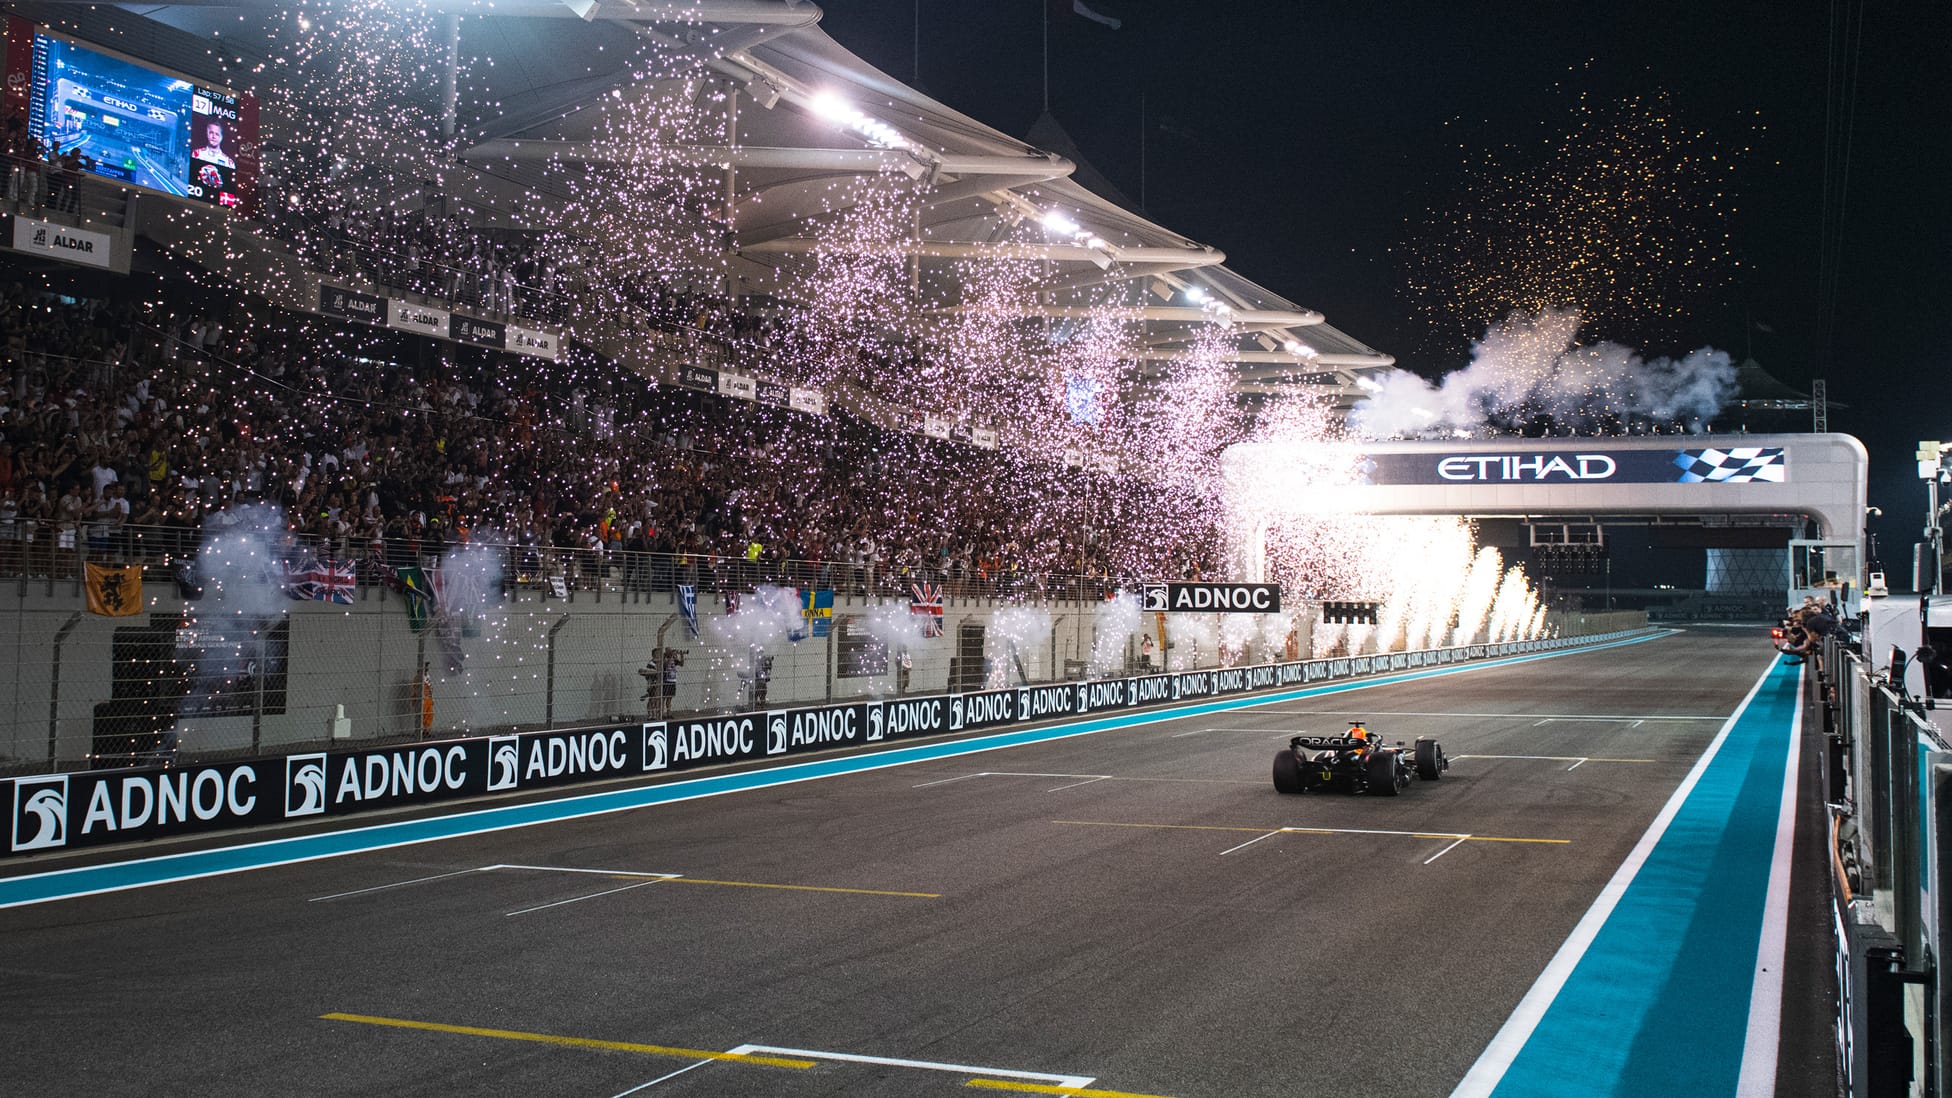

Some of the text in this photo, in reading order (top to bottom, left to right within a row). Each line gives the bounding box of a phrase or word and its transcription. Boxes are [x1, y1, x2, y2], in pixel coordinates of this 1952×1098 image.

[103, 96, 138, 112] ETIHAD
[195, 99, 207, 110] 17
[213, 105, 236, 120] MAG
[187, 184, 203, 197] 20
[53, 235, 94, 254] ALDAR
[347, 299, 377, 314] ALDAR
[472, 326, 497, 339] ALDAR
[1437, 455, 1616, 480] ETIHAD
[1176, 587, 1271, 609] ADNOC
[1182, 673, 1207, 695] ADNOC
[1219, 670, 1242, 690] ADNOC
[1253, 666, 1274, 686] ADNOC
[1283, 664, 1301, 682] ADNOC
[1089, 682, 1123, 707] ADNOC
[1139, 677, 1169, 701] ADNOC
[966, 693, 1012, 723] ADNOC
[1033, 687, 1071, 715] ADNOC
[792, 708, 857, 746] ADNOC
[887, 700, 941, 733] ADNOC
[674, 719, 754, 761] ADNOC
[1299, 737, 1359, 745] ORACLE
[526, 731, 627, 779] ADNOC
[336, 745, 467, 803] ADNOC
[81, 766, 257, 834] ADNOC
